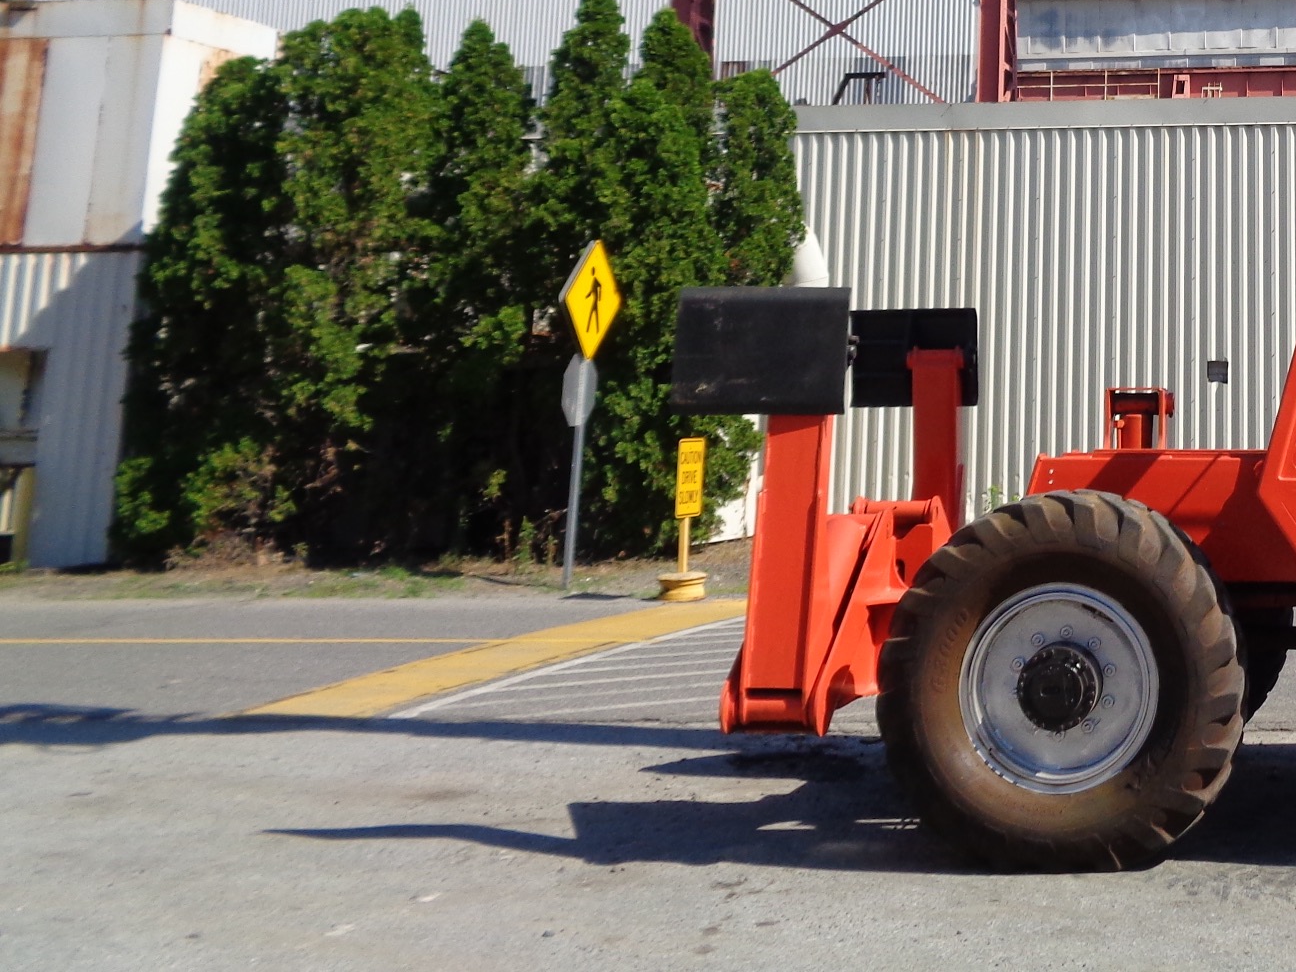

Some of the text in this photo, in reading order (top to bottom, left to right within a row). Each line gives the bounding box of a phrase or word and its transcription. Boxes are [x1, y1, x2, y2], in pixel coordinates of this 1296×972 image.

[680, 450, 702, 465] CAUTION
[681, 469, 698, 485] DRIVE
[679, 489, 699, 505] SLOWLY
